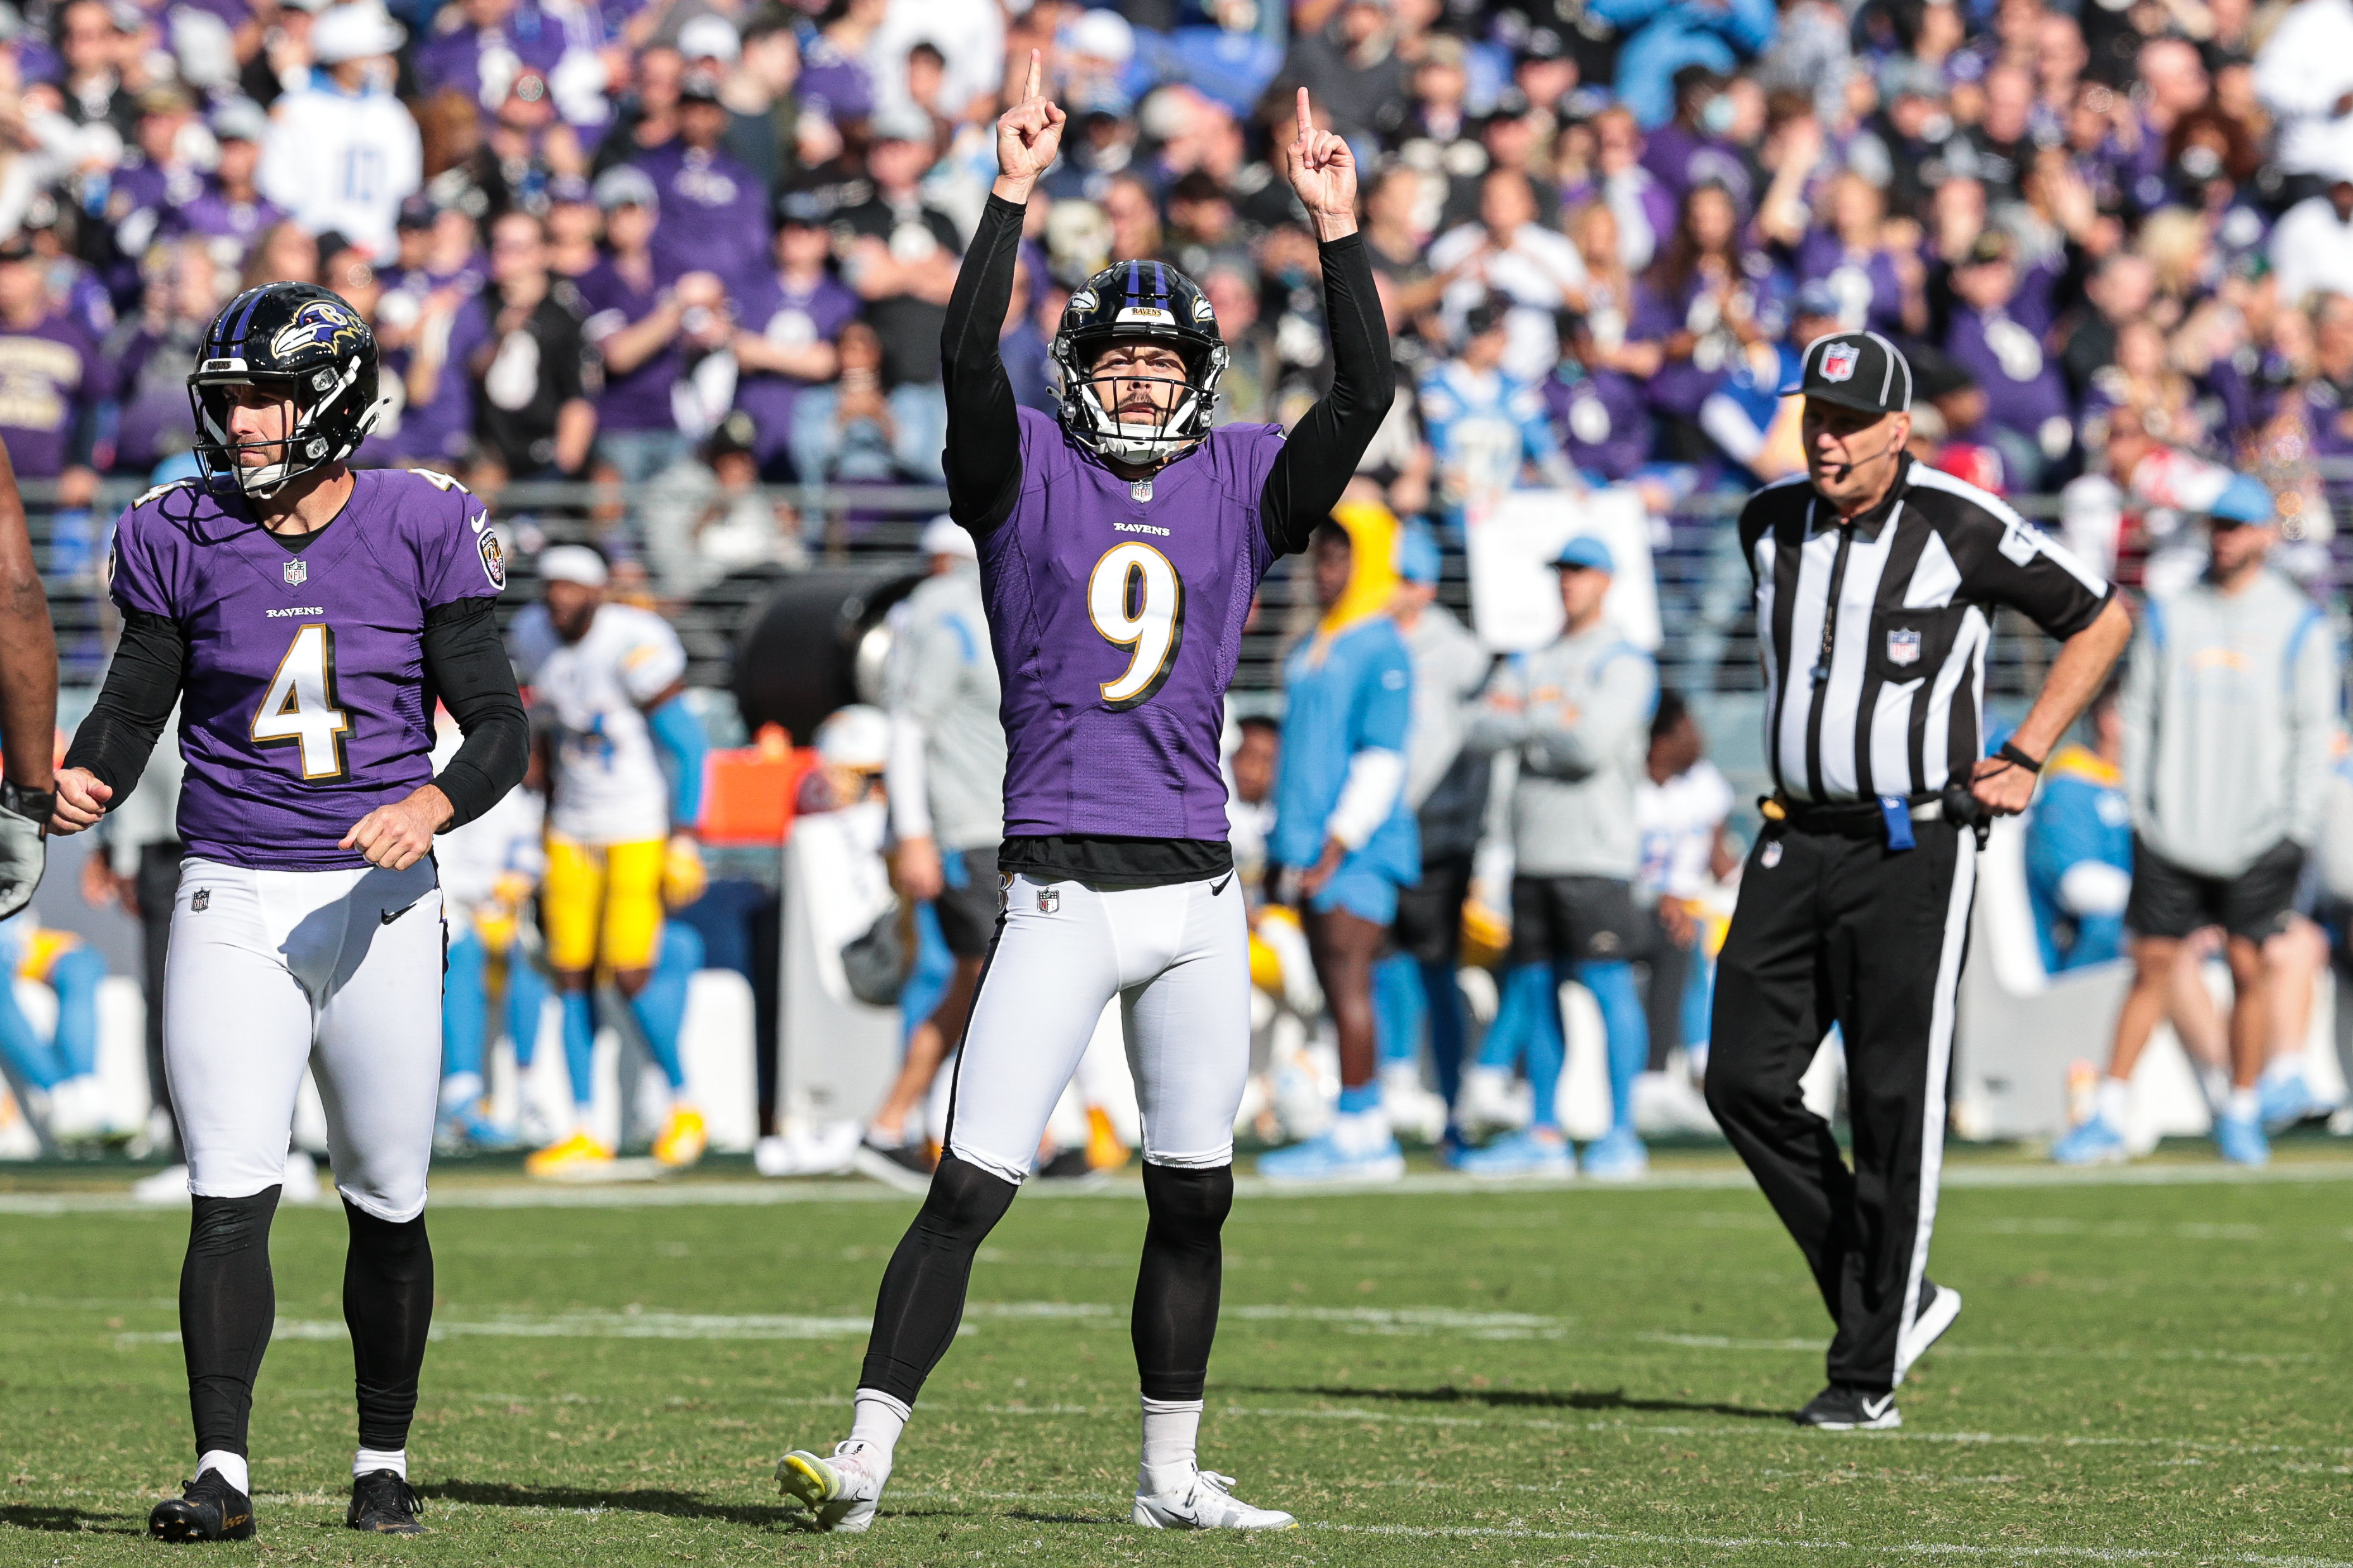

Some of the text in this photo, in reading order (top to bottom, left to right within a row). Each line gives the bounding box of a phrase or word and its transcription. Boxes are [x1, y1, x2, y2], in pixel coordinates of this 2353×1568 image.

[318, 305, 348, 326] B
[1132, 308, 1161, 316] RAVENS
[408, 468, 471, 495] 4
[1113, 523, 1171, 536] RAVENS
[288, 571, 302, 580] NFL
[266, 607, 324, 617] RAVENS
[1087, 541, 1186, 710] 9
[250, 623, 356, 787] 4
